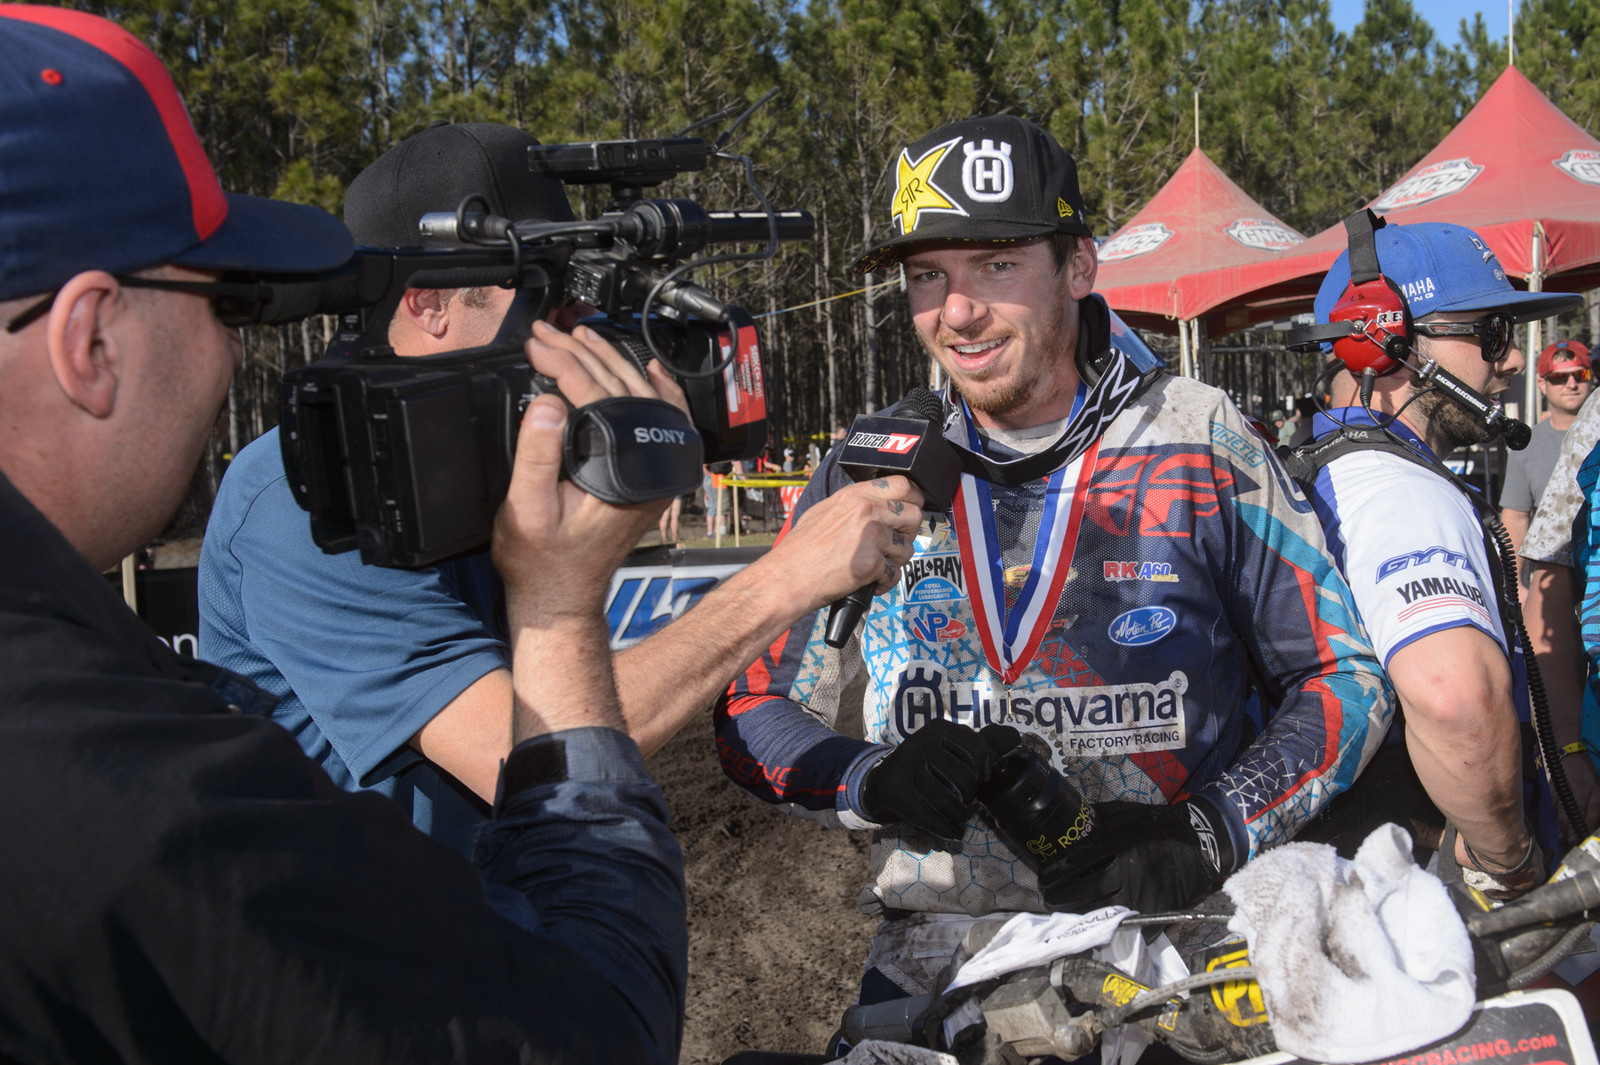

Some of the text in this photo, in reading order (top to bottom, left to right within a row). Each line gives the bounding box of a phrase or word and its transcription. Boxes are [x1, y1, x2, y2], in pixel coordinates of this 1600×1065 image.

[1400, 277, 1435, 299] MAHA
[1435, 374, 1488, 412] RACING ELECTRONICS
[633, 426, 685, 445] SONY
[884, 435, 920, 450] TV
[1104, 561, 1138, 579] RK
[915, 587, 953, 595] PERFORMANCE
[1396, 577, 1488, 613] YAMALUB
[913, 612, 949, 643] VP
[1115, 612, 1171, 640] Motion Pro
[951, 687, 1178, 734] Husqvarna
[1070, 730, 1180, 750] FACTORY RACING
